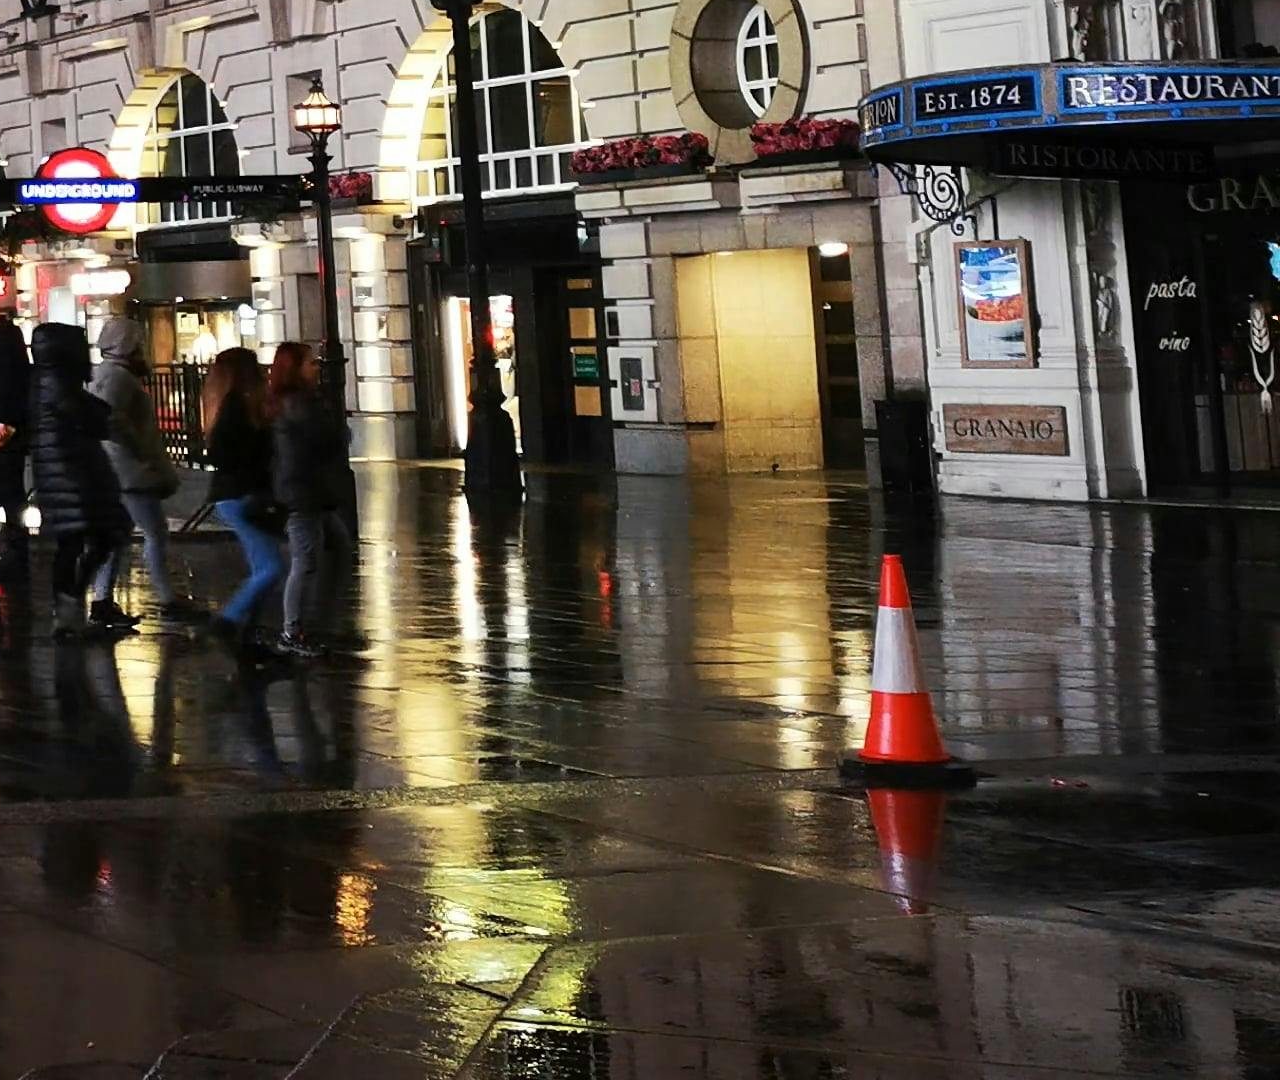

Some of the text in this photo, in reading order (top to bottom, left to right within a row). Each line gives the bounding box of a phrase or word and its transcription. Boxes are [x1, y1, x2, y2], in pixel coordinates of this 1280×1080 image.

[970, 84, 1022, 109] 1874
[1008, 143, 1206, 173] RISTORANTE
[21, 183, 137, 199] UNDERGROUND
[193, 184, 264, 194] PUBLIC SUBWAY
[1144, 275, 1198, 311] pasta
[1158, 331, 1191, 352] vino
[953, 418, 1054, 440] GRANAIO
